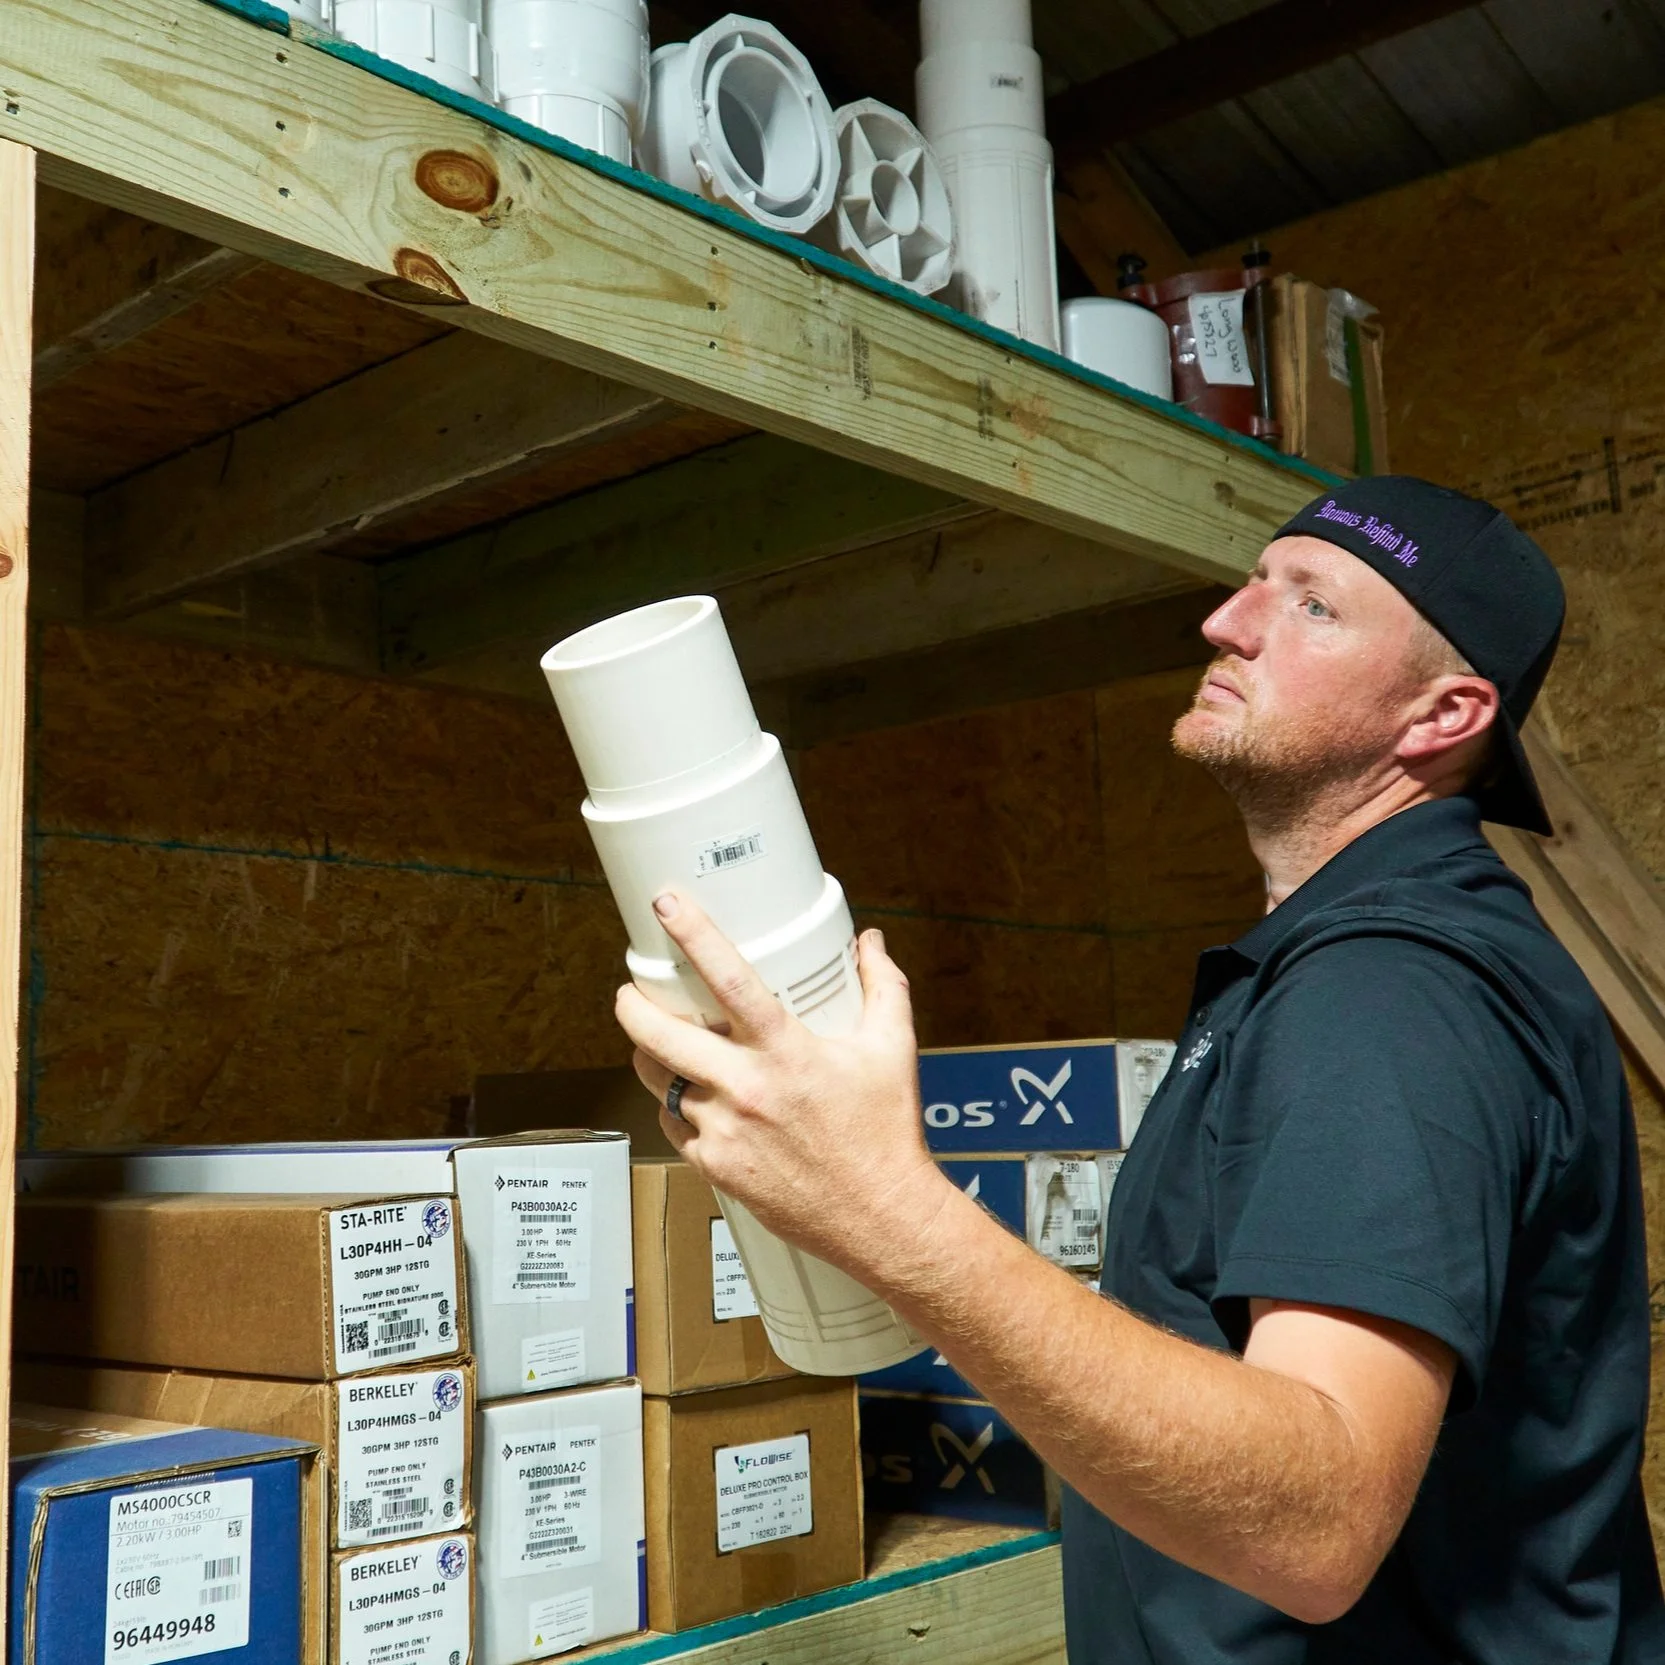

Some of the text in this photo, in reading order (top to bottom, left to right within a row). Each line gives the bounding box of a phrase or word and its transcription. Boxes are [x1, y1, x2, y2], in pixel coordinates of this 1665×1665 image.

[507, 1179, 549, 1188] PENTAIR
[562, 1181, 587, 1189] PENTEK
[511, 1201, 578, 1212] P43B0030A2-C
[340, 1207, 405, 1230] STA-RITE
[526, 1251, 557, 1260] XE-Series
[715, 1252, 740, 1262] DELUX
[353, 1260, 430, 1280] 30GPM 3HP 12STG
[363, 1284, 420, 1301] PUMP END ONLY
[520, 1281, 559, 1290] Submersible
[559, 1280, 577, 1289] Motor
[349, 1383, 415, 1403] BERKELEY
[361, 1436, 439, 1455] 30GPM 3HP 12STG
[515, 1442, 557, 1456] PENTAIR
[570, 1438, 596, 1449] PENTEK
[368, 1462, 427, 1477] PUMP END ONLY
[519, 1461, 586, 1480] P43B0030A2-C
[365, 1474, 422, 1489] STAINLESS STEEL
[720, 1470, 809, 1497] DELUXE PRO CONTROL BOX
[117, 1490, 211, 1516] MS4000CSCR
[116, 1517, 149, 1533] Motor
[535, 1516, 566, 1527] XE-Series
[116, 1532, 157, 1548] 2.20kW
[529, 1547, 568, 1560] Submersible
[351, 1555, 419, 1582] BERKELEY
[363, 1609, 444, 1634] 30GPM 3HP 12STG
[113, 1613, 216, 1651] 96449948
[370, 1636, 431, 1656] PUMP END ONLY
[367, 1647, 425, 1665] STAINLESS STEEL
